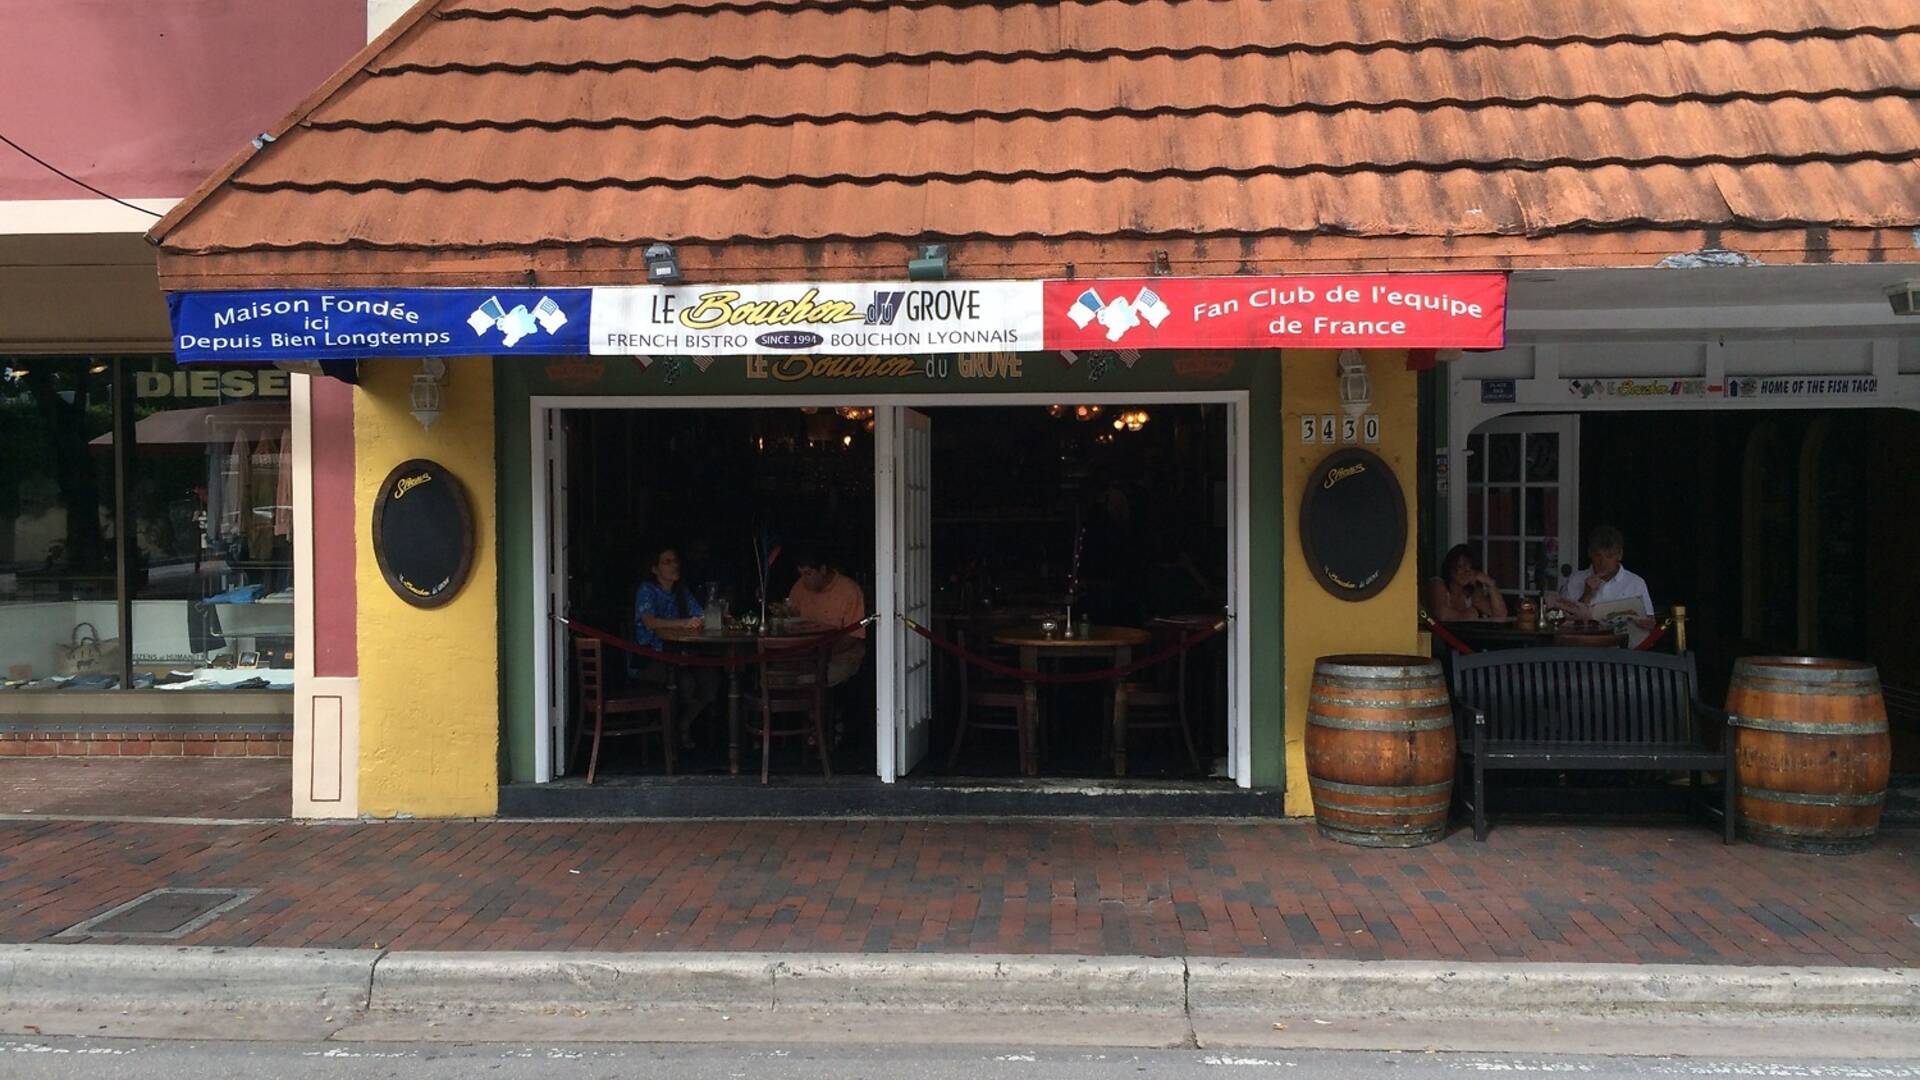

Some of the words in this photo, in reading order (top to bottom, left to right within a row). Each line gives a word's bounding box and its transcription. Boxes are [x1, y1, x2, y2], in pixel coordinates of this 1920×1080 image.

[214, 301, 309, 328] Maison
[321, 295, 419, 324] Fondée
[652, 295, 676, 323] LE
[679, 288, 866, 329] Bouchon
[866, 290, 893, 324] du
[906, 290, 981, 321] GROVE
[1193, 299, 1239, 321] Fan
[1249, 286, 1315, 307] Club
[1326, 285, 1360, 303] de
[1372, 286, 1483, 318] l'equipe
[304, 316, 329, 330] ici
[1269, 316, 1303, 334] de
[1314, 317, 1406, 334] France
[180, 335, 262, 351] Depuis
[271, 333, 316, 347] Bien
[325, 332, 450, 347] Longtemps
[608, 334, 678, 347] FRENCH
[685, 335, 748, 347] BISTRO
[762, 335, 790, 345] SINCE
[793, 334, 817, 344] 1994
[831, 333, 920, 346] BOUCHON
[928, 329, 1018, 345] LYONNAIS
[1760, 381, 1789, 394] HOME
[1792, 381, 1804, 393] OF
[1807, 381, 1825, 393] THE
[1827, 380, 1849, 393] FISH
[1304, 420, 1378, 439] 3430
